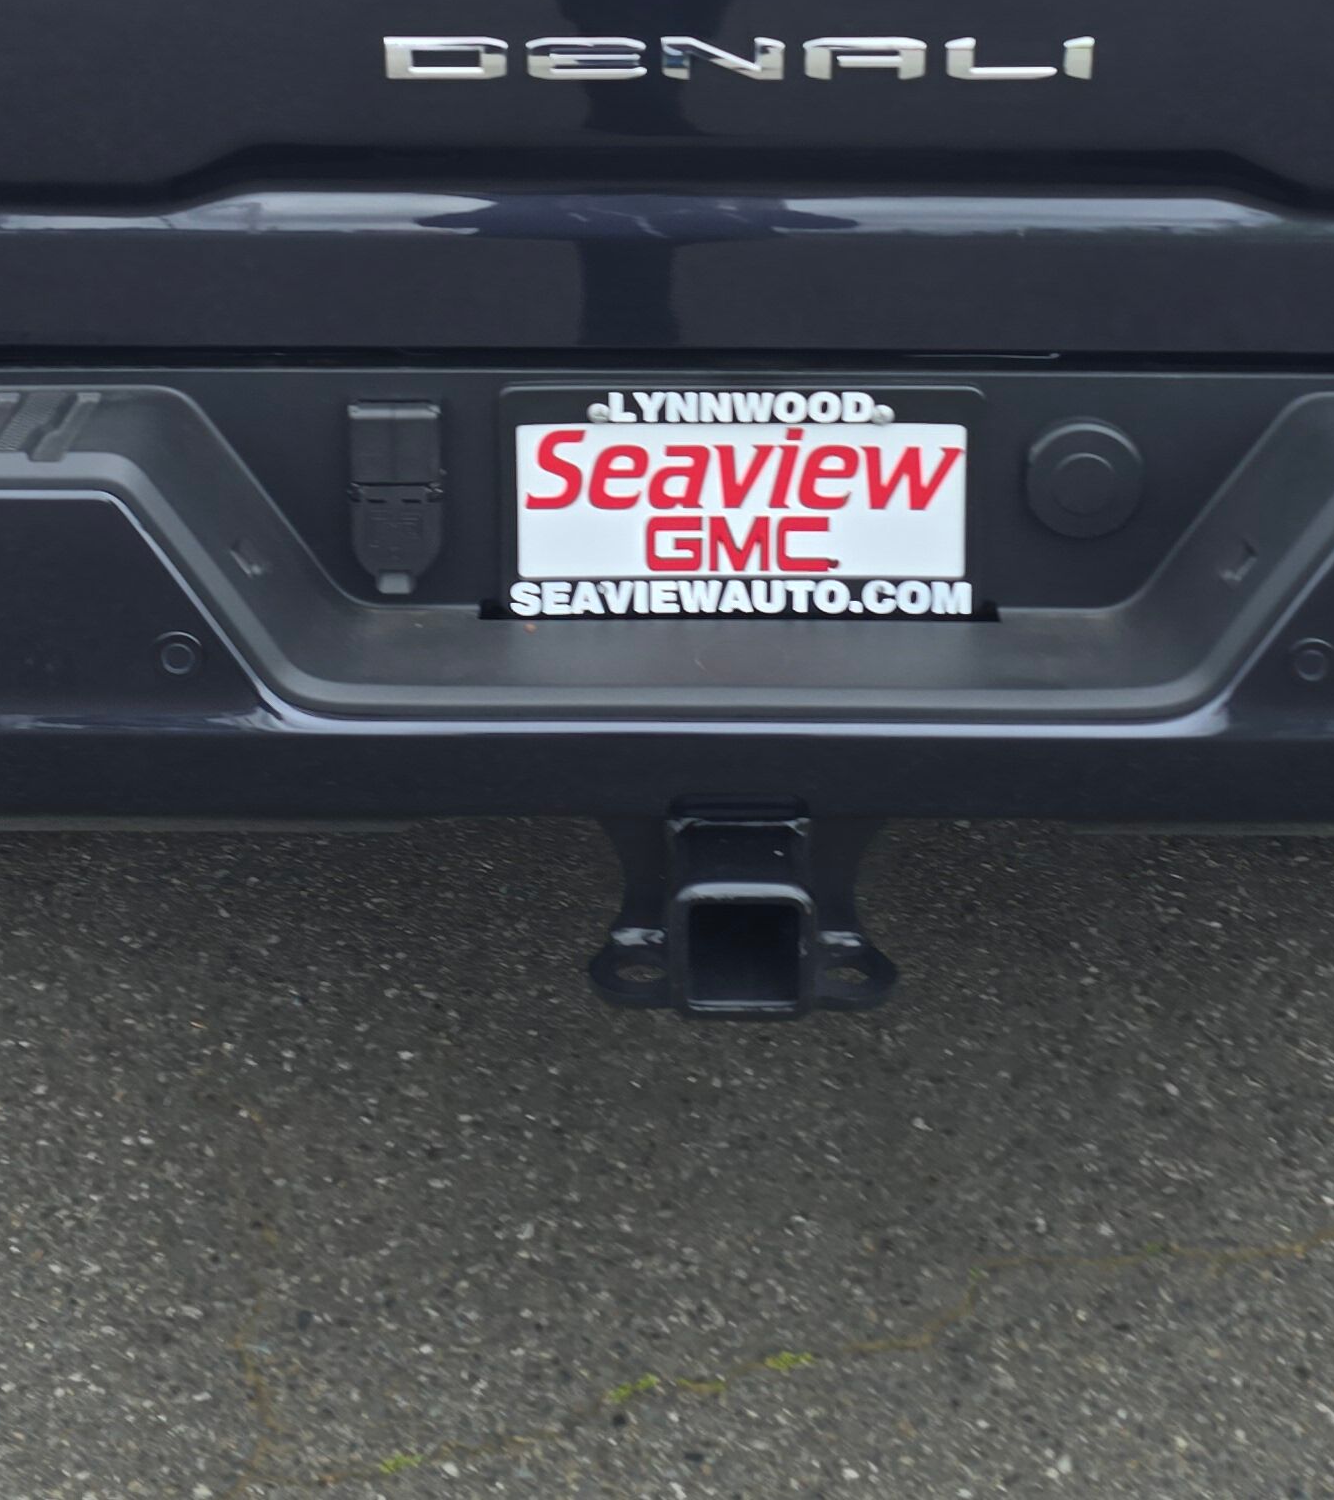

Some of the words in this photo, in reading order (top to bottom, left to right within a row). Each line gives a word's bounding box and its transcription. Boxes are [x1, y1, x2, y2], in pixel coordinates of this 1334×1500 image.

[383, 36, 1095, 80] DENALI
[608, 392, 875, 423] LYNNWOOD
[524, 428, 965, 510] Seaview
[646, 516, 839, 572] GMC
[509, 580, 973, 616] SEAVIEWAUTO.COM
